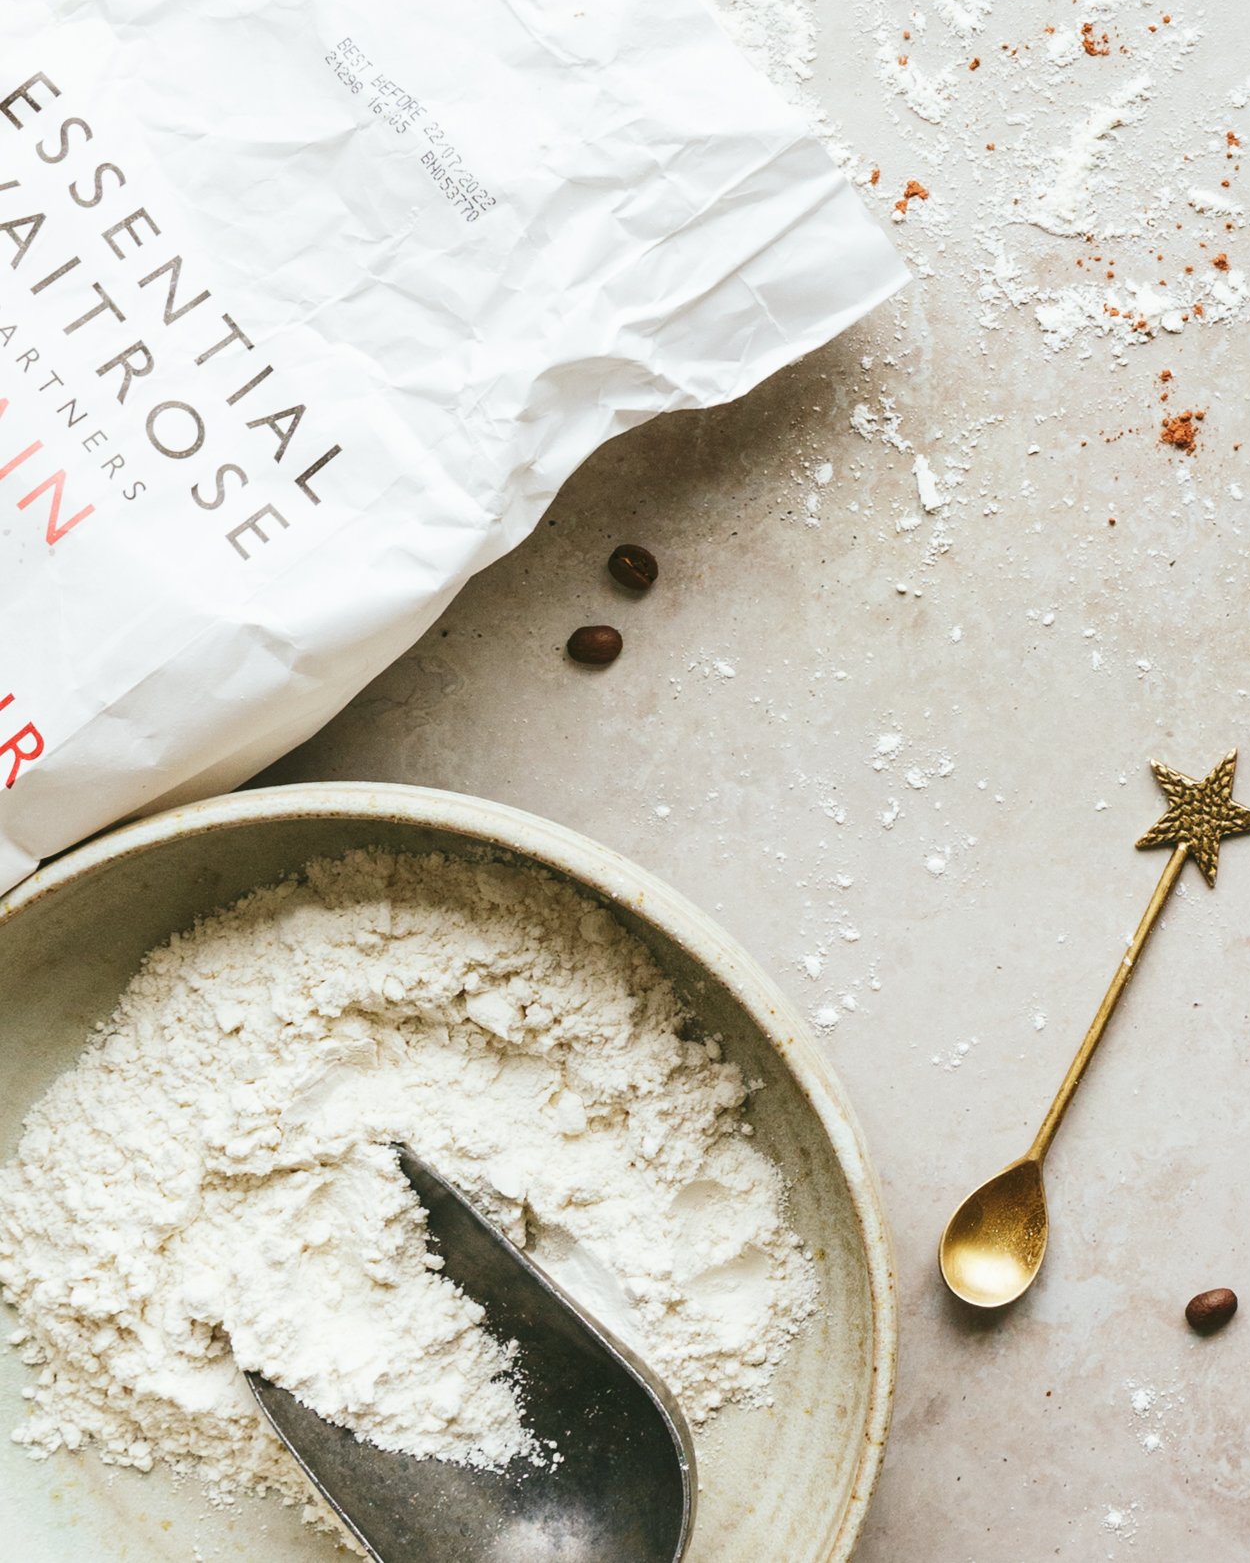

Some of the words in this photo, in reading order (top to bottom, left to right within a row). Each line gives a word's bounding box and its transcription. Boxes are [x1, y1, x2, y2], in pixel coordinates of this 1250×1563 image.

[336, 37, 374, 74] BEST
[370, 74, 428, 122] BEFORE
[423, 122, 497, 212] 22/07/2022
[0, 71, 343, 506] ESSENTIAL
[0, 179, 290, 561] AITROSE
[0, 325, 146, 501] ARTNERS
